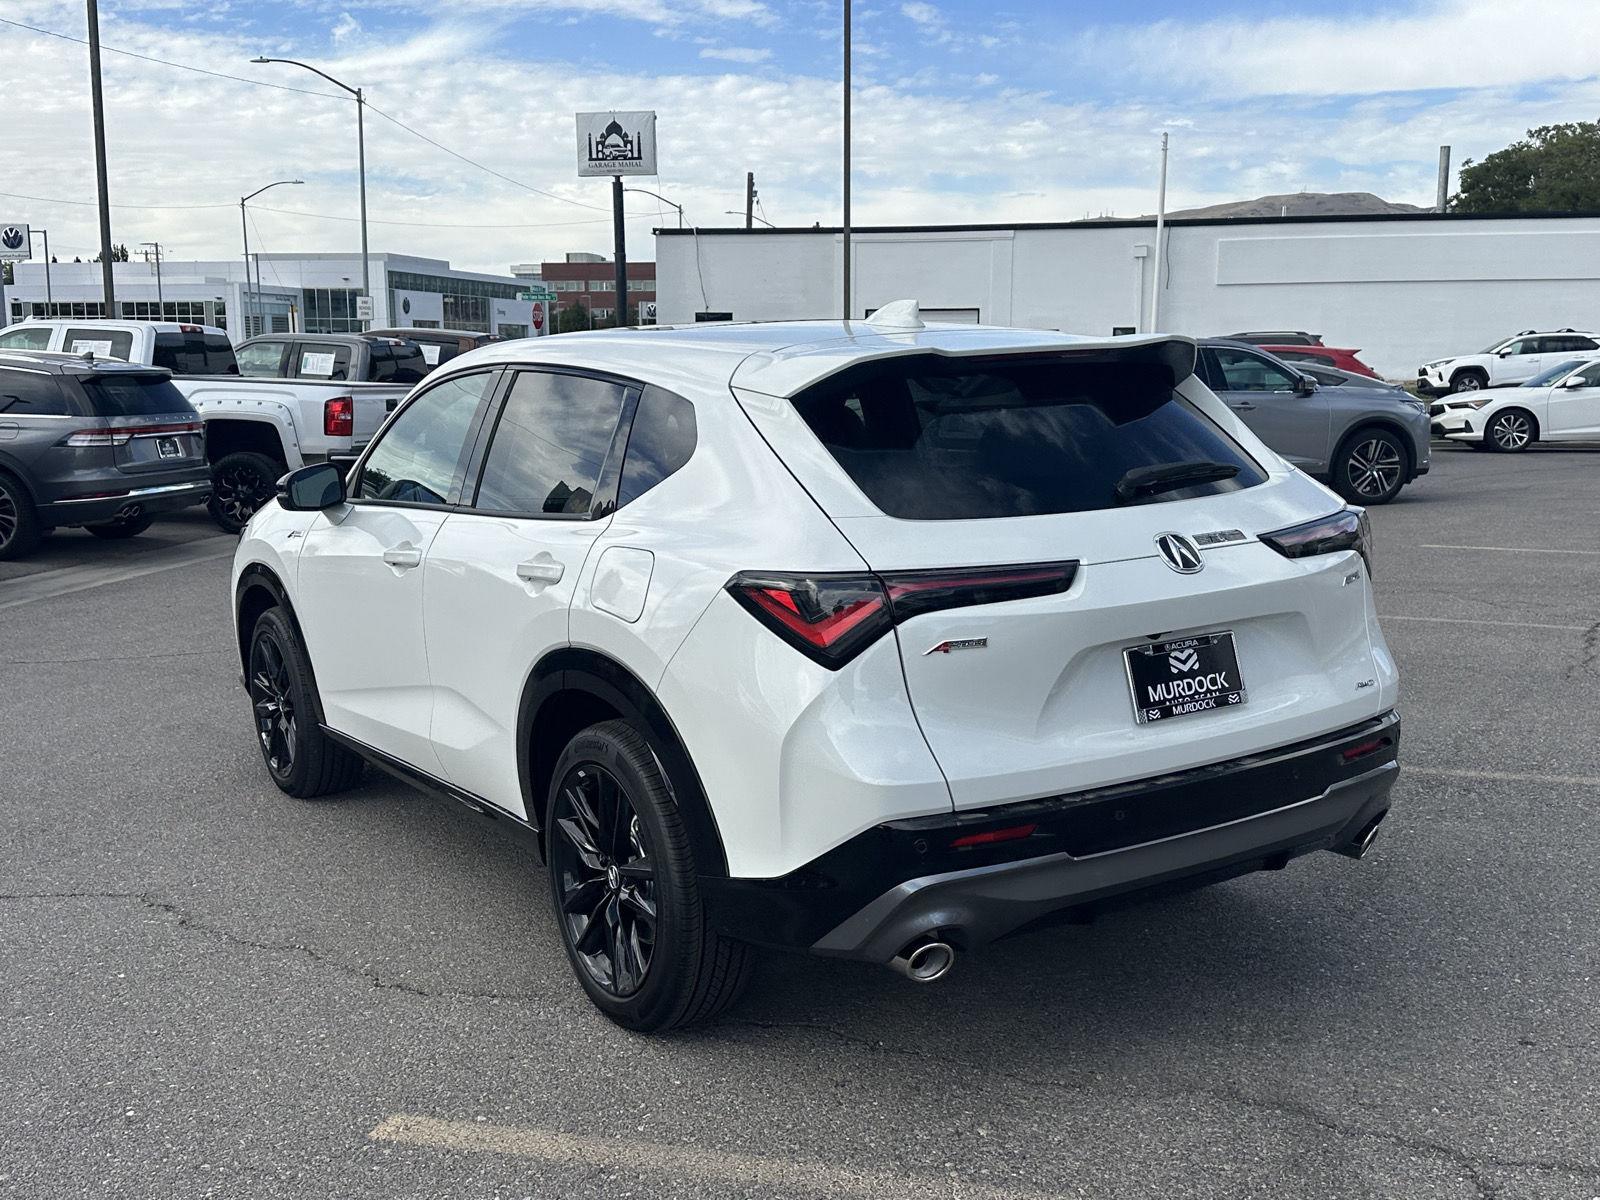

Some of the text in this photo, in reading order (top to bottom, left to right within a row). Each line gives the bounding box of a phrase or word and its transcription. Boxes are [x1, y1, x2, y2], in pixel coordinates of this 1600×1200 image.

[588, 160, 643, 169] GARAGE MAHAL
[533, 310, 544, 322] STOP
[1171, 639, 1200, 650] ACURA
[1147, 671, 1229, 703] MURDOCK
[1172, 698, 1216, 715] MURDOCK
